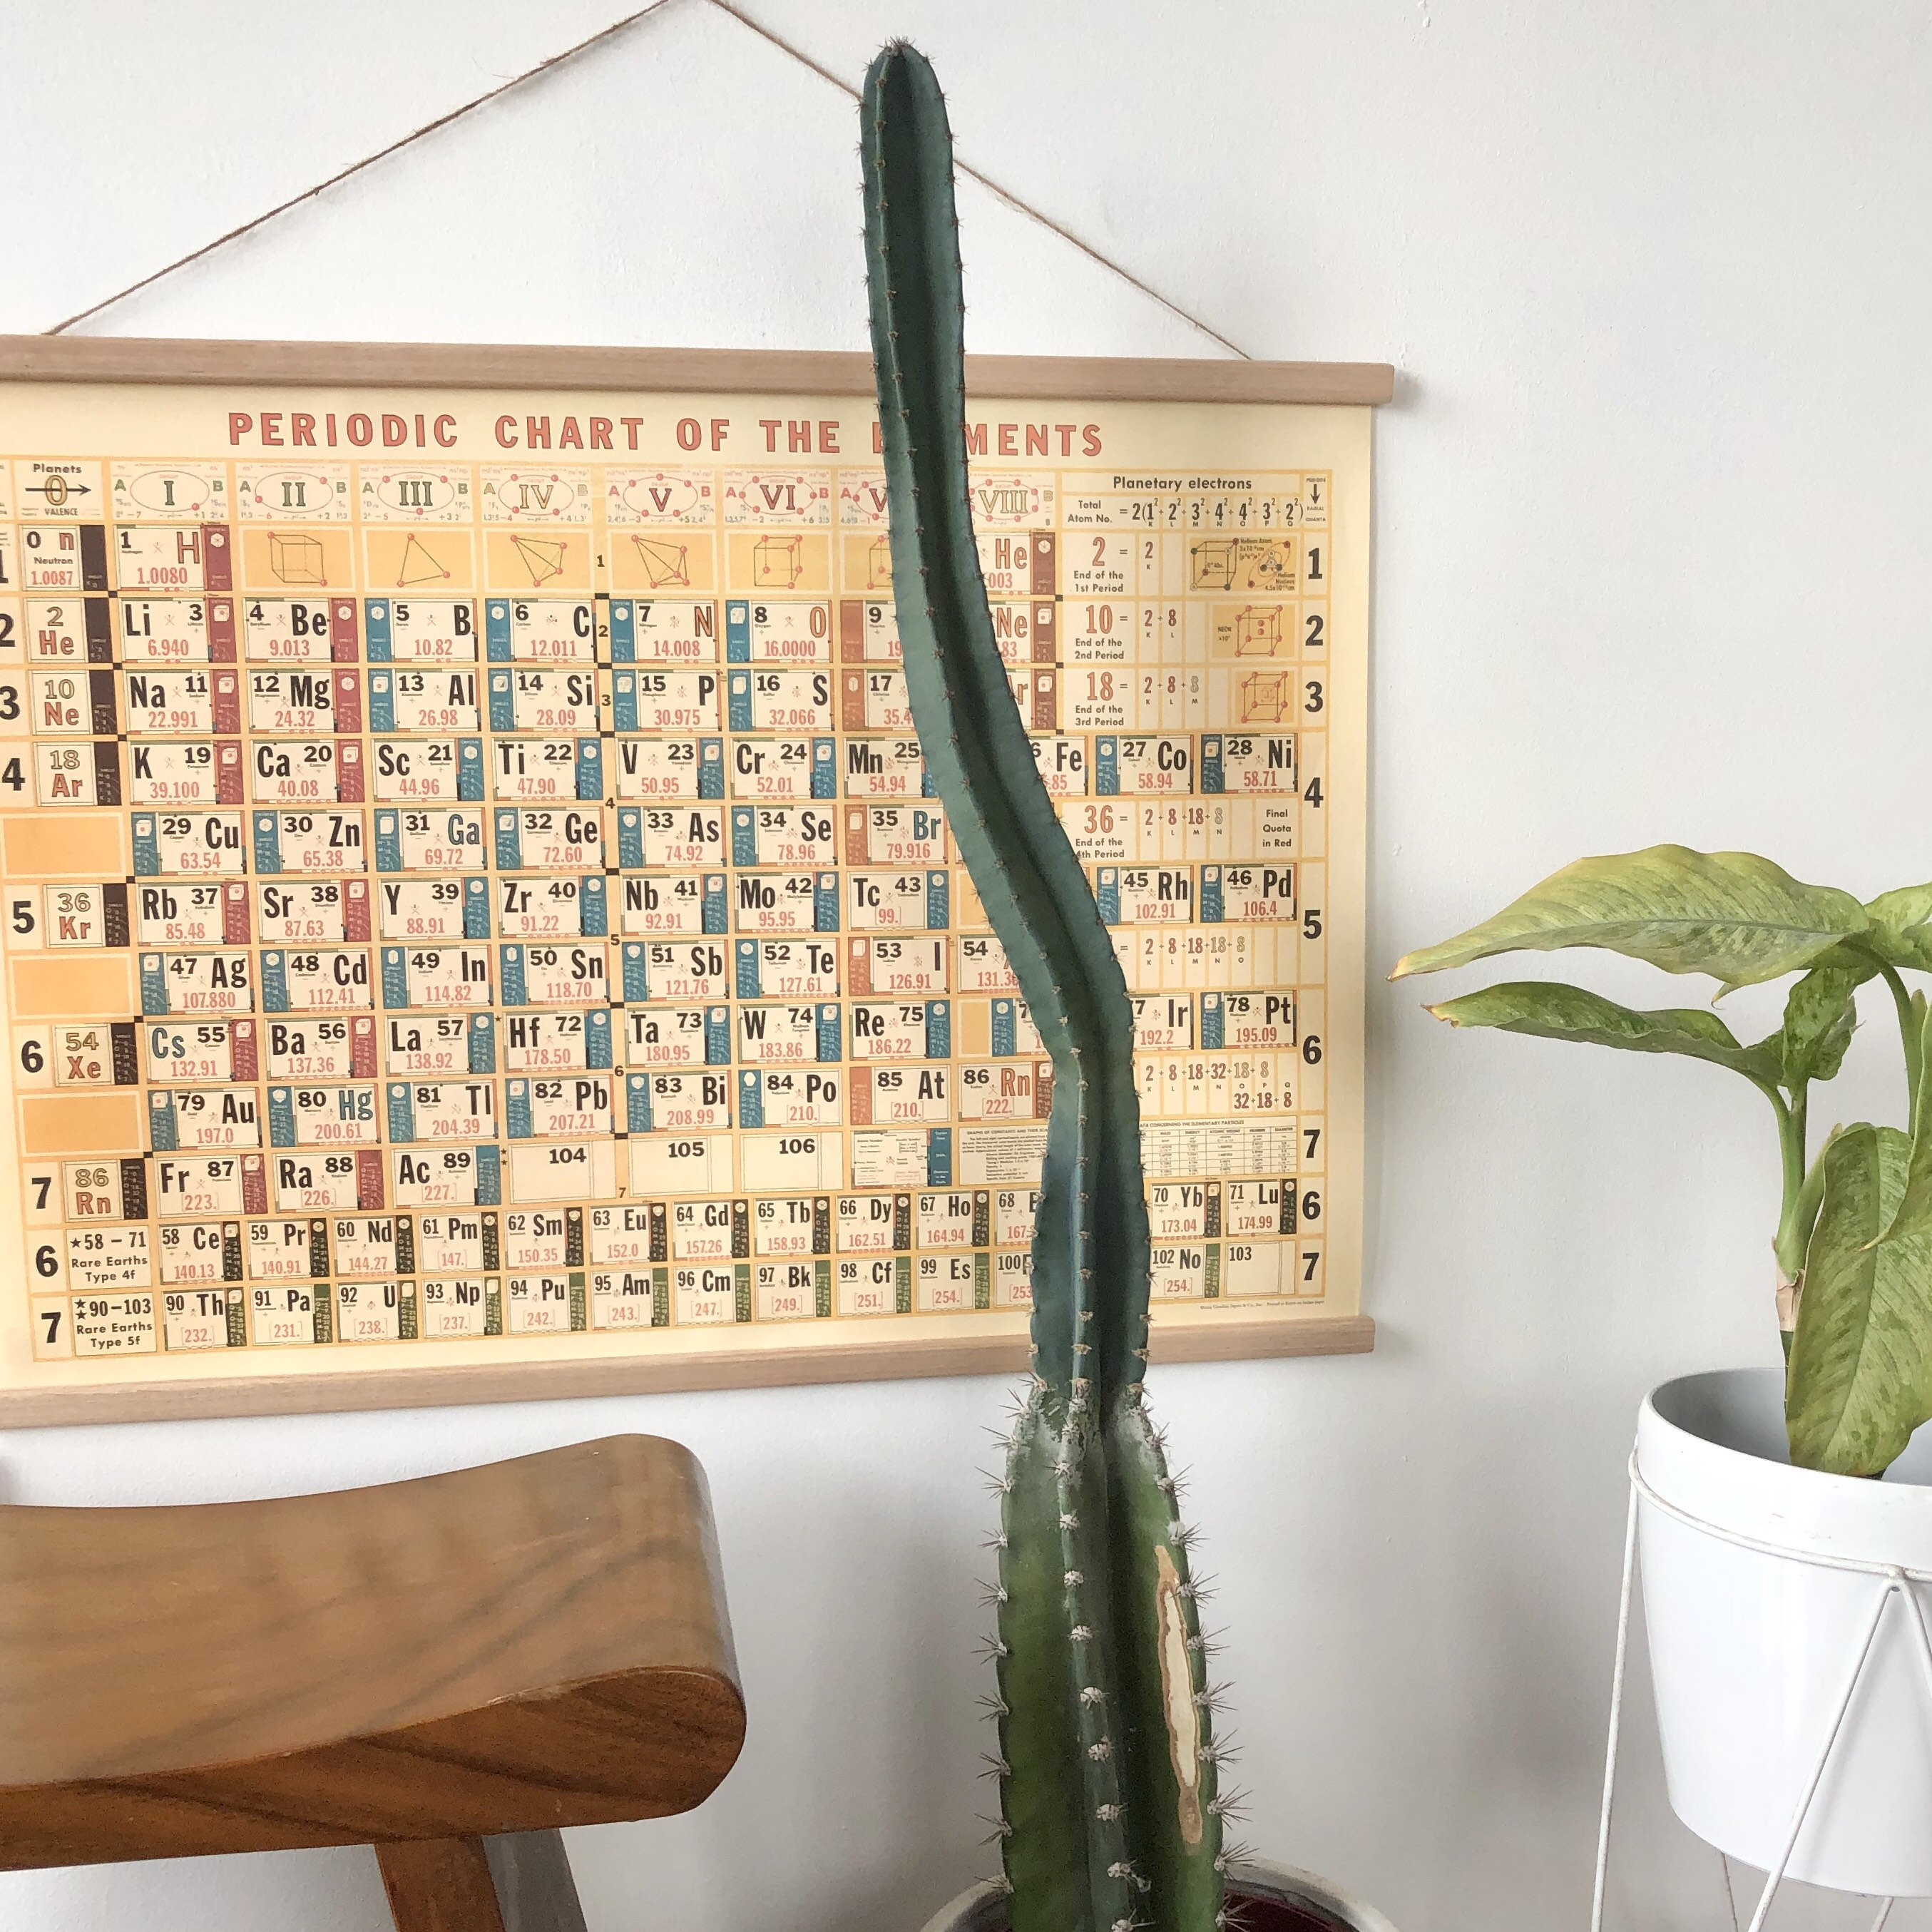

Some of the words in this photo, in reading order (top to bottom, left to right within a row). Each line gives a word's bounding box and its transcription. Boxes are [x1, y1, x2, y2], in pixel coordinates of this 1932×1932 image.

[229, 412, 457, 447] PERIODIC
[495, 415, 643, 450] CHART
[677, 418, 730, 451] OF
[759, 420, 839, 453] THE
[34, 464, 81, 473] Planets
[282, 482, 306, 506] II
[399, 481, 433, 506] III
[1114, 476, 1182, 492] Planetary
[1189, 478, 1251, 489] electrons
[519, 484, 553, 509] IV
[649, 488, 672, 512] V
[760, 485, 795, 510] VI
[978, 490, 1028, 513] VIII
[1078, 500, 1100, 508] Total
[1096, 514, 1112, 523] No.
[121, 531, 131, 548] 1
[176, 531, 200, 564] H
[996, 538, 1027, 569] He
[1093, 537, 1105, 566] 2
[597, 555, 605, 567] 1
[1309, 548, 1322, 579] 1
[31, 571, 73, 586] 1.0087
[137, 567, 188, 584] 1.0080
[1073, 571, 1091, 580] End
[1095, 571, 1105, 580] of
[1109, 571, 1123, 579] the
[1075, 583, 1088, 592] 1st
[1093, 583, 1123, 592] Period
[0, 613, 15, 647] 2
[126, 604, 150, 635] Li
[190, 604, 203, 620] 3
[516, 605, 528, 620] 6
[574, 606, 589, 637] C
[755, 606, 767, 623] 8
[809, 606, 826, 638] O
[1086, 605, 1113, 634] 10
[598, 625, 608, 637] 2
[1306, 615, 1323, 646] 2
[148, 639, 188, 655] 6.940
[531, 640, 577, 656] 12.011
[765, 640, 816, 657] 16.0000
[1075, 638, 1092, 647] End
[1095, 638, 1105, 647] of
[1108, 638, 1123, 647] the
[1075, 650, 1092, 659] 2nd
[1095, 650, 1124, 659] Period
[254, 676, 280, 692] 12
[290, 675, 329, 709] Mg
[1087, 672, 1113, 701] 18
[1305, 682, 1323, 712] 3
[0, 686, 20, 720] 3
[602, 695, 610, 706] 3
[1075, 705, 1092, 714] End
[1096, 705, 1105, 713] of
[275, 710, 315, 727] 24.32
[50, 750, 80, 770] 18
[134, 747, 153, 779] K
[185, 747, 210, 763] 19
[498, 744, 524, 775] Ti
[544, 745, 572, 760] 22
[1227, 740, 1252, 755] 28
[1269, 740, 1291, 768] Ni
[2, 758, 25, 791] 4
[1244, 771, 1277, 787] 58.71
[51, 774, 83, 797] Ar
[150, 782, 200, 799] 39.100
[518, 778, 556, 794] 47.90
[1304, 777, 1324, 808] 4
[605, 797, 615, 809] 4
[1267, 809, 1287, 817] Final
[873, 810, 898, 826] 35
[914, 811, 941, 840] Br
[1084, 805, 1113, 834] 36
[887, 843, 930, 859] 79.916
[1075, 838, 1092, 847] End
[1095, 837, 1105, 847] of
[1108, 837, 1123, 847] the
[1076, 850, 1091, 859] 4th
[1095, 849, 1124, 858] Period
[1227, 870, 1252, 885] 46
[1263, 869, 1291, 898] Pd
[13, 901, 34, 934] 5
[1244, 901, 1277, 916] 106.4
[1303, 910, 1322, 939] 5
[611, 934, 620, 946] 5
[170, 959, 197, 974] 47
[211, 958, 247, 988] Ag
[531, 950, 557, 966] 50
[571, 949, 603, 979] Sn
[183, 992, 235, 1008] 107.880
[547, 982, 592, 998] 118.70
[1227, 997, 1249, 1012] 78
[1266, 996, 1291, 1024] Pt
[1237, 1027, 1277, 1042] 195.09
[21, 1041, 44, 1073] 6
[1303, 1036, 1322, 1064] 6
[615, 1065, 624, 1077] 6
[964, 1069, 989, 1084] 86
[1001, 1068, 1030, 1097] Rn
[536, 1083, 562, 1098] 82
[576, 1080, 607, 1110] Pb
[178, 1095, 205, 1110] 79
[223, 1094, 254, 1124] Au
[550, 1114, 595, 1130] 207.21
[197, 1128, 233, 1143] 197.0
[780, 1138, 814, 1154] 106
[1304, 1129, 1320, 1158] 7
[550, 1148, 586, 1164] 104
[668, 1142, 704, 1157] 105
[32, 1177, 51, 1209] 7
[619, 1187, 626, 1198] 7
[921, 1197, 935, 1212] 67
[949, 1196, 970, 1217] Ho
[1302, 1191, 1320, 1220] 6
[163, 1229, 180, 1244] 58
[193, 1227, 219, 1249] Ce
[928, 1229, 964, 1243] 164.94
[36, 1246, 58, 1277] 6
[72, 1258, 101, 1268] Rare
[106, 1255, 148, 1266] Earths
[1230, 1247, 1252, 1261] 103
[85, 1272, 116, 1284] Type
[122, 1269, 136, 1279] 4f
[175, 1264, 215, 1279] 140.13
[1302, 1252, 1319, 1280] 7
[341, 1287, 357, 1303] 92
[384, 1286, 395, 1307] U
[41, 1312, 61, 1343] 7
[76, 1324, 106, 1334] Rare
[111, 1322, 153, 1332] Earths
[91, 1338, 122, 1350] Type
[128, 1336, 140, 1346] 5f
